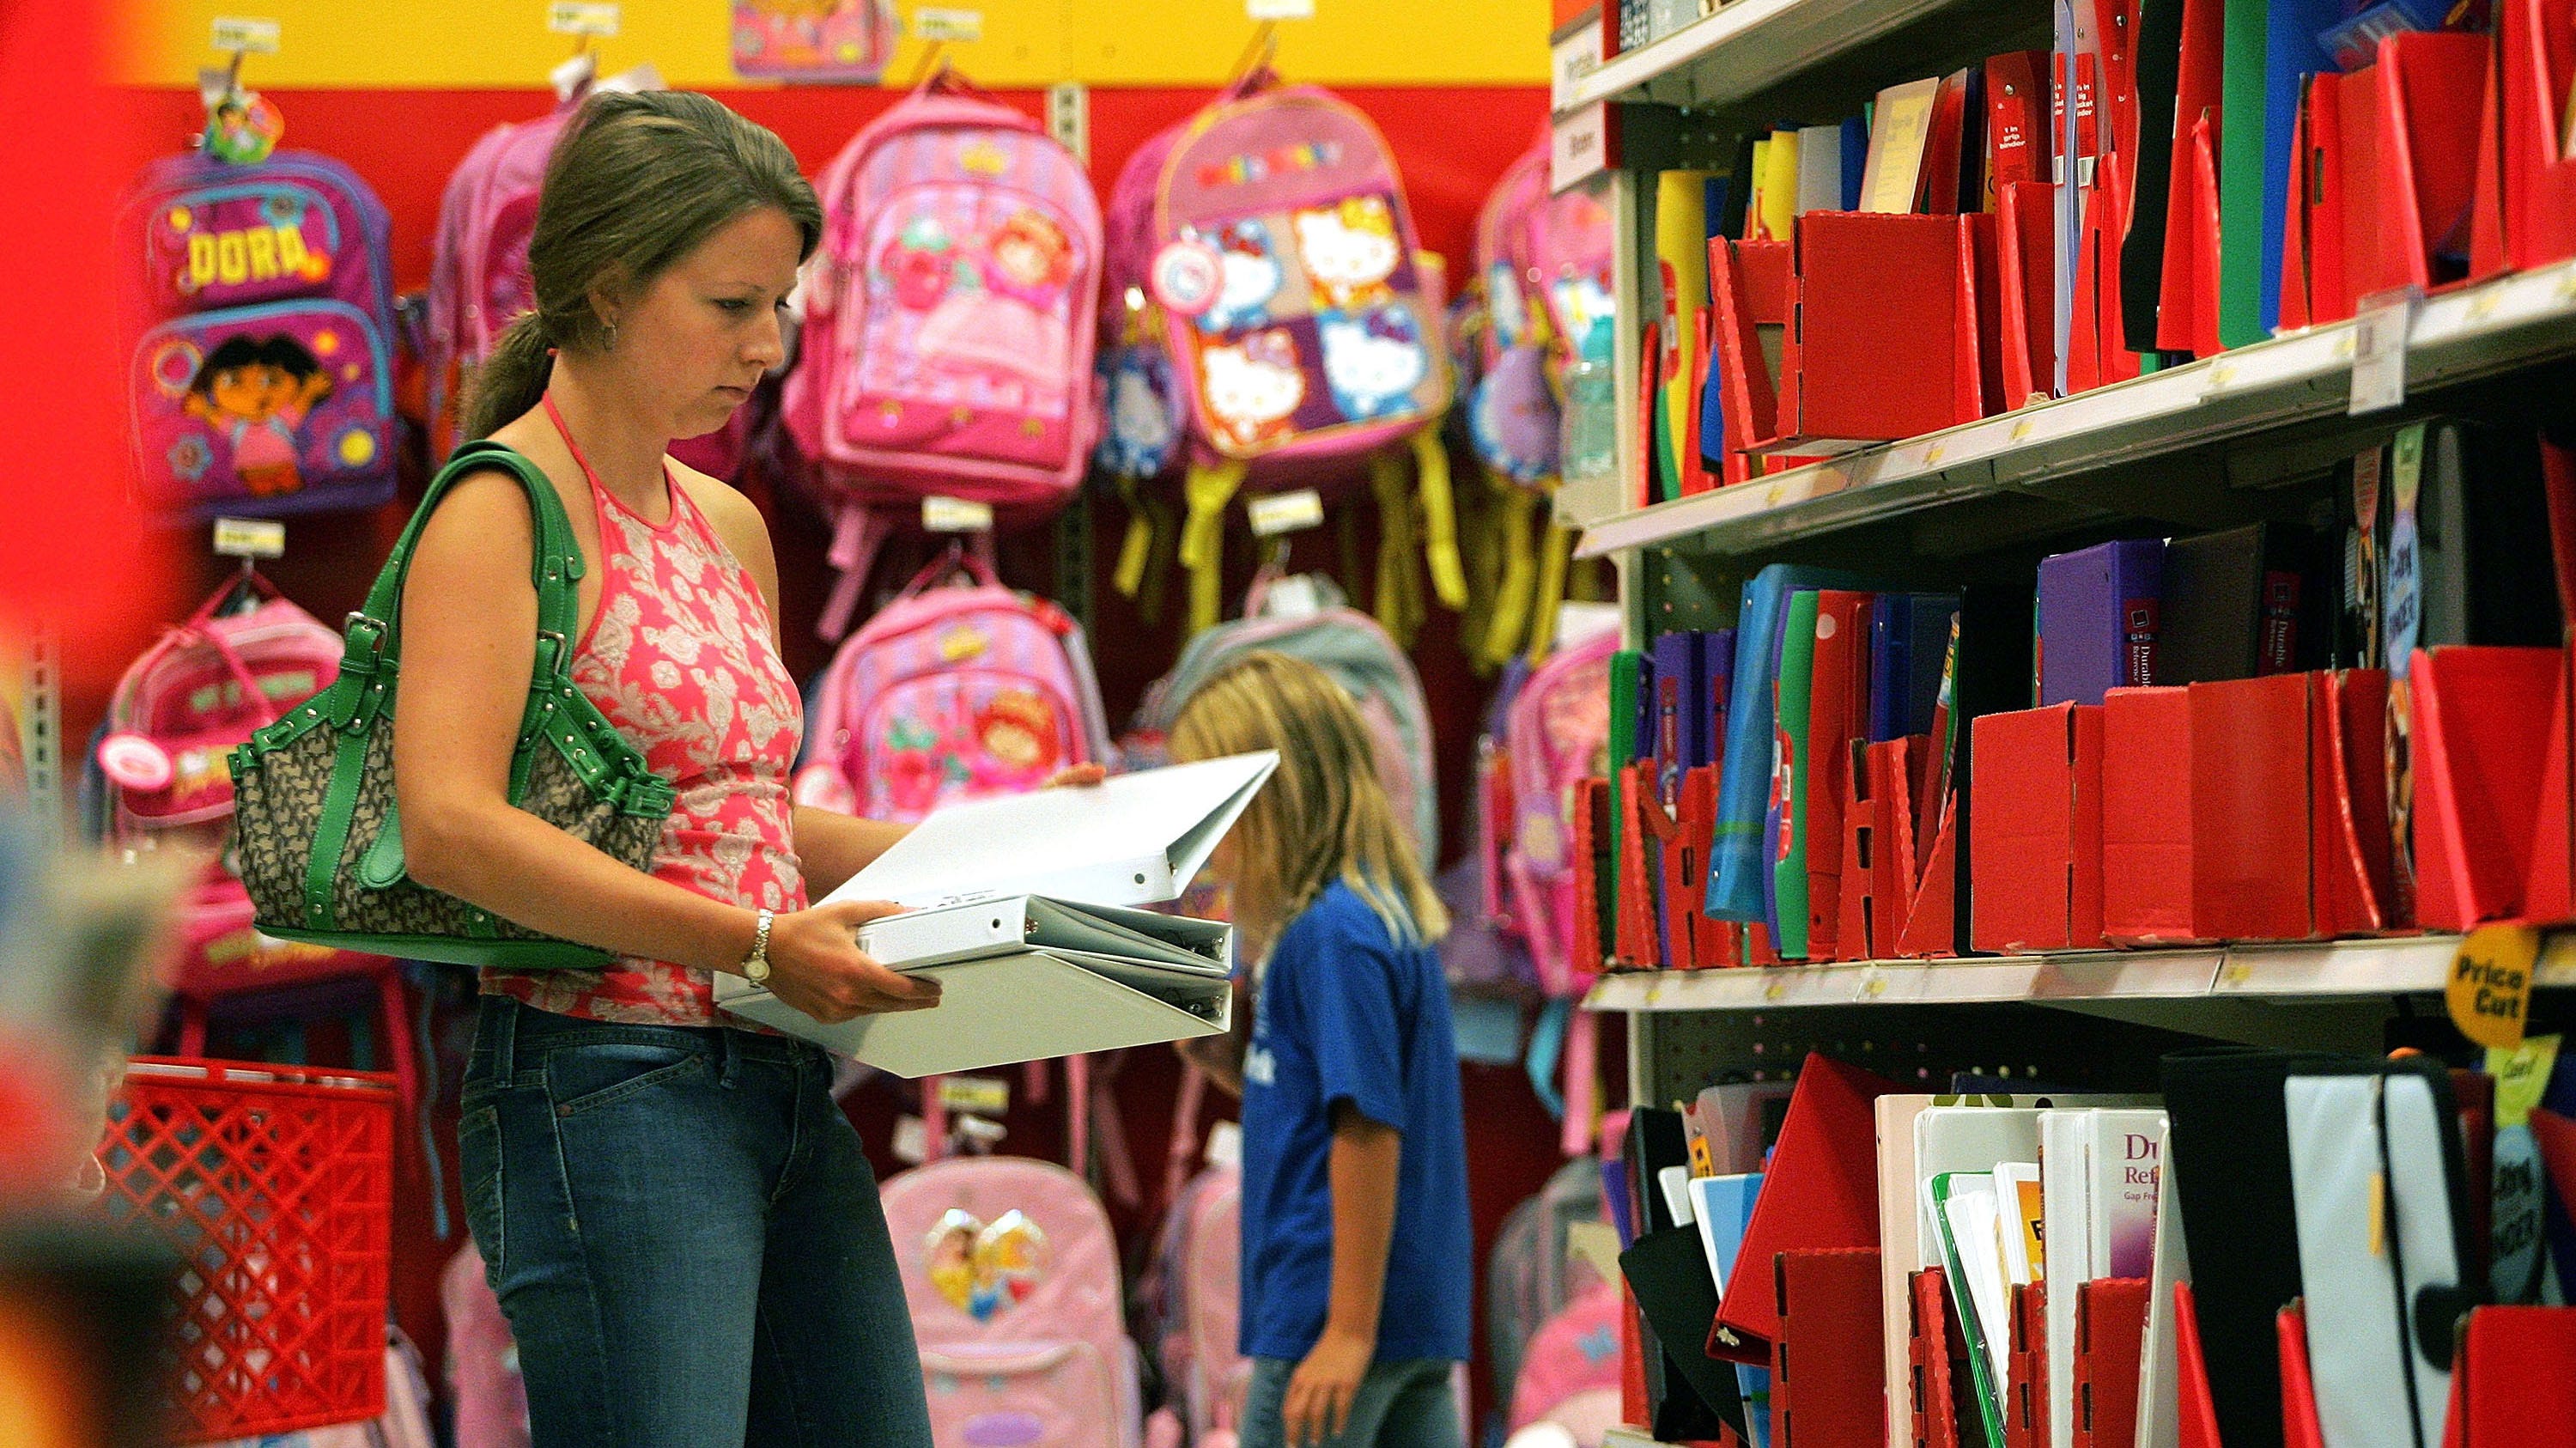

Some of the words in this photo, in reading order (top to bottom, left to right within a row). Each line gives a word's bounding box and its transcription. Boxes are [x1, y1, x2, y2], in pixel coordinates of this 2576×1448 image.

[188, 225, 307, 285] DORA
[2458, 954, 2524, 989] Price
[2475, 988, 2520, 1019] Cut
[2123, 1191, 2141, 1202] Gap
